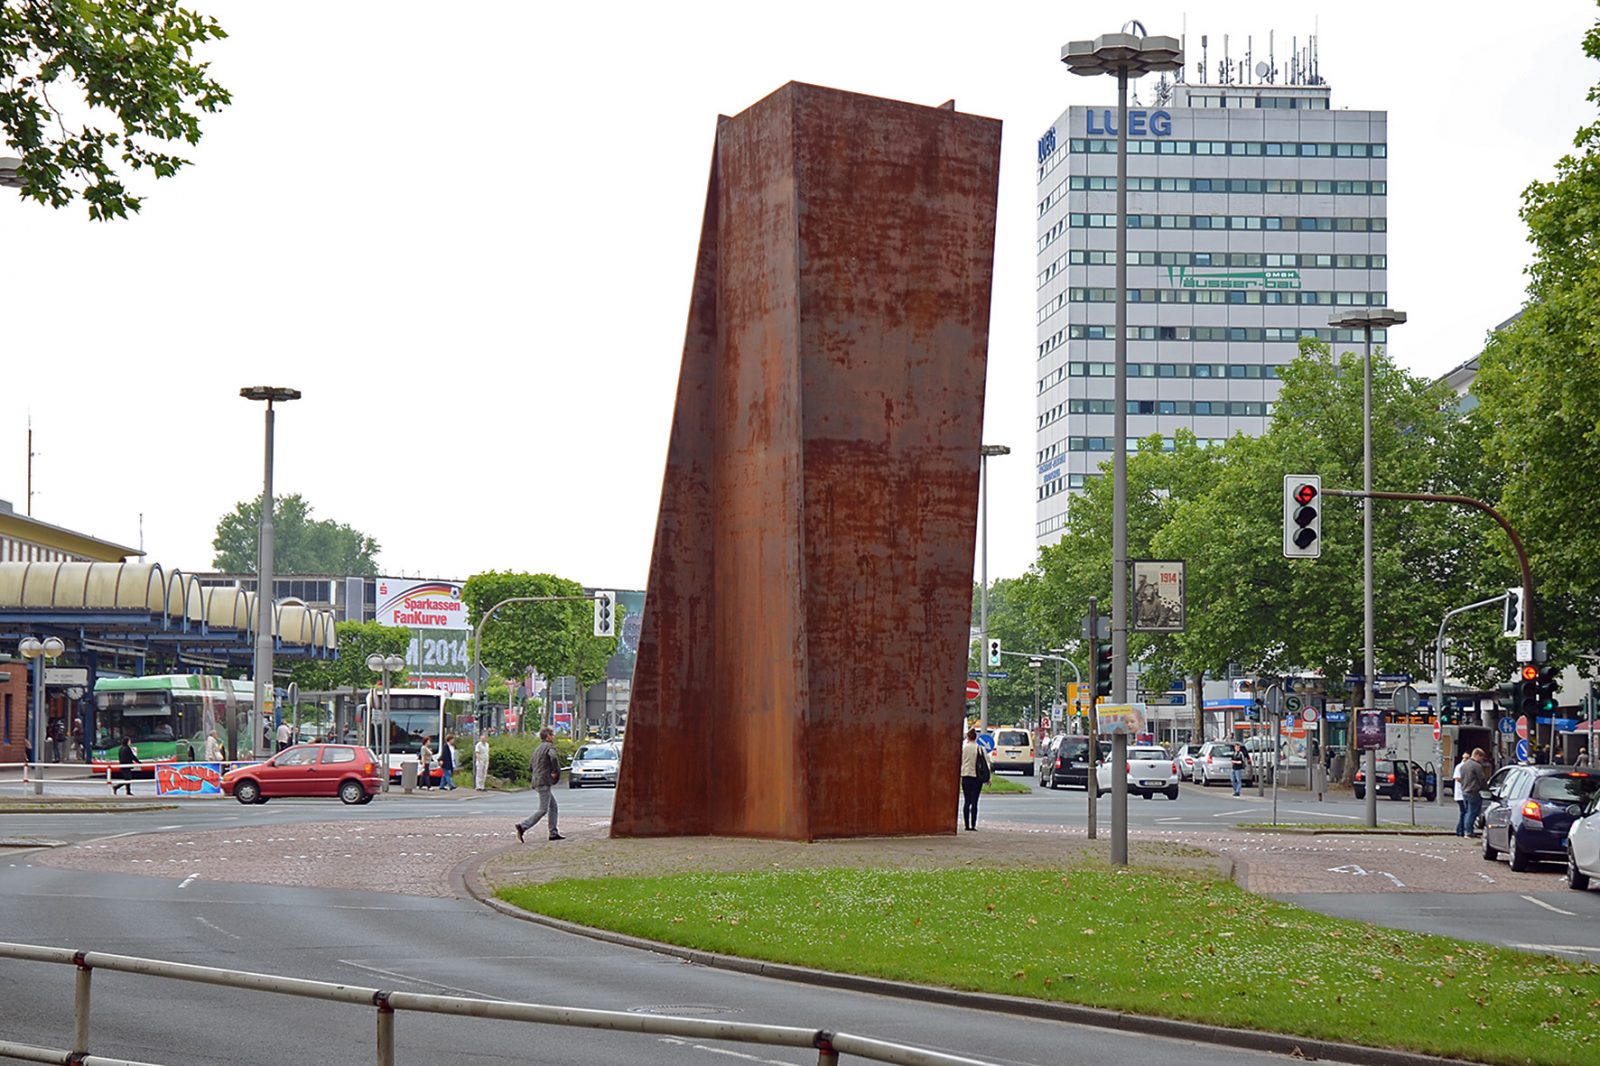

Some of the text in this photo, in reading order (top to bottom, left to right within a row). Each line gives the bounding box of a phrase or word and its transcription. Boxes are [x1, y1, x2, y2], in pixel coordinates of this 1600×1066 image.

[1087, 109, 1171, 136] LUEG
[1160, 572, 1177, 583] 1914
[404, 598, 461, 612] Sparkassen
[393, 610, 447, 626] FanKurve
[423, 638, 470, 668] 2014
